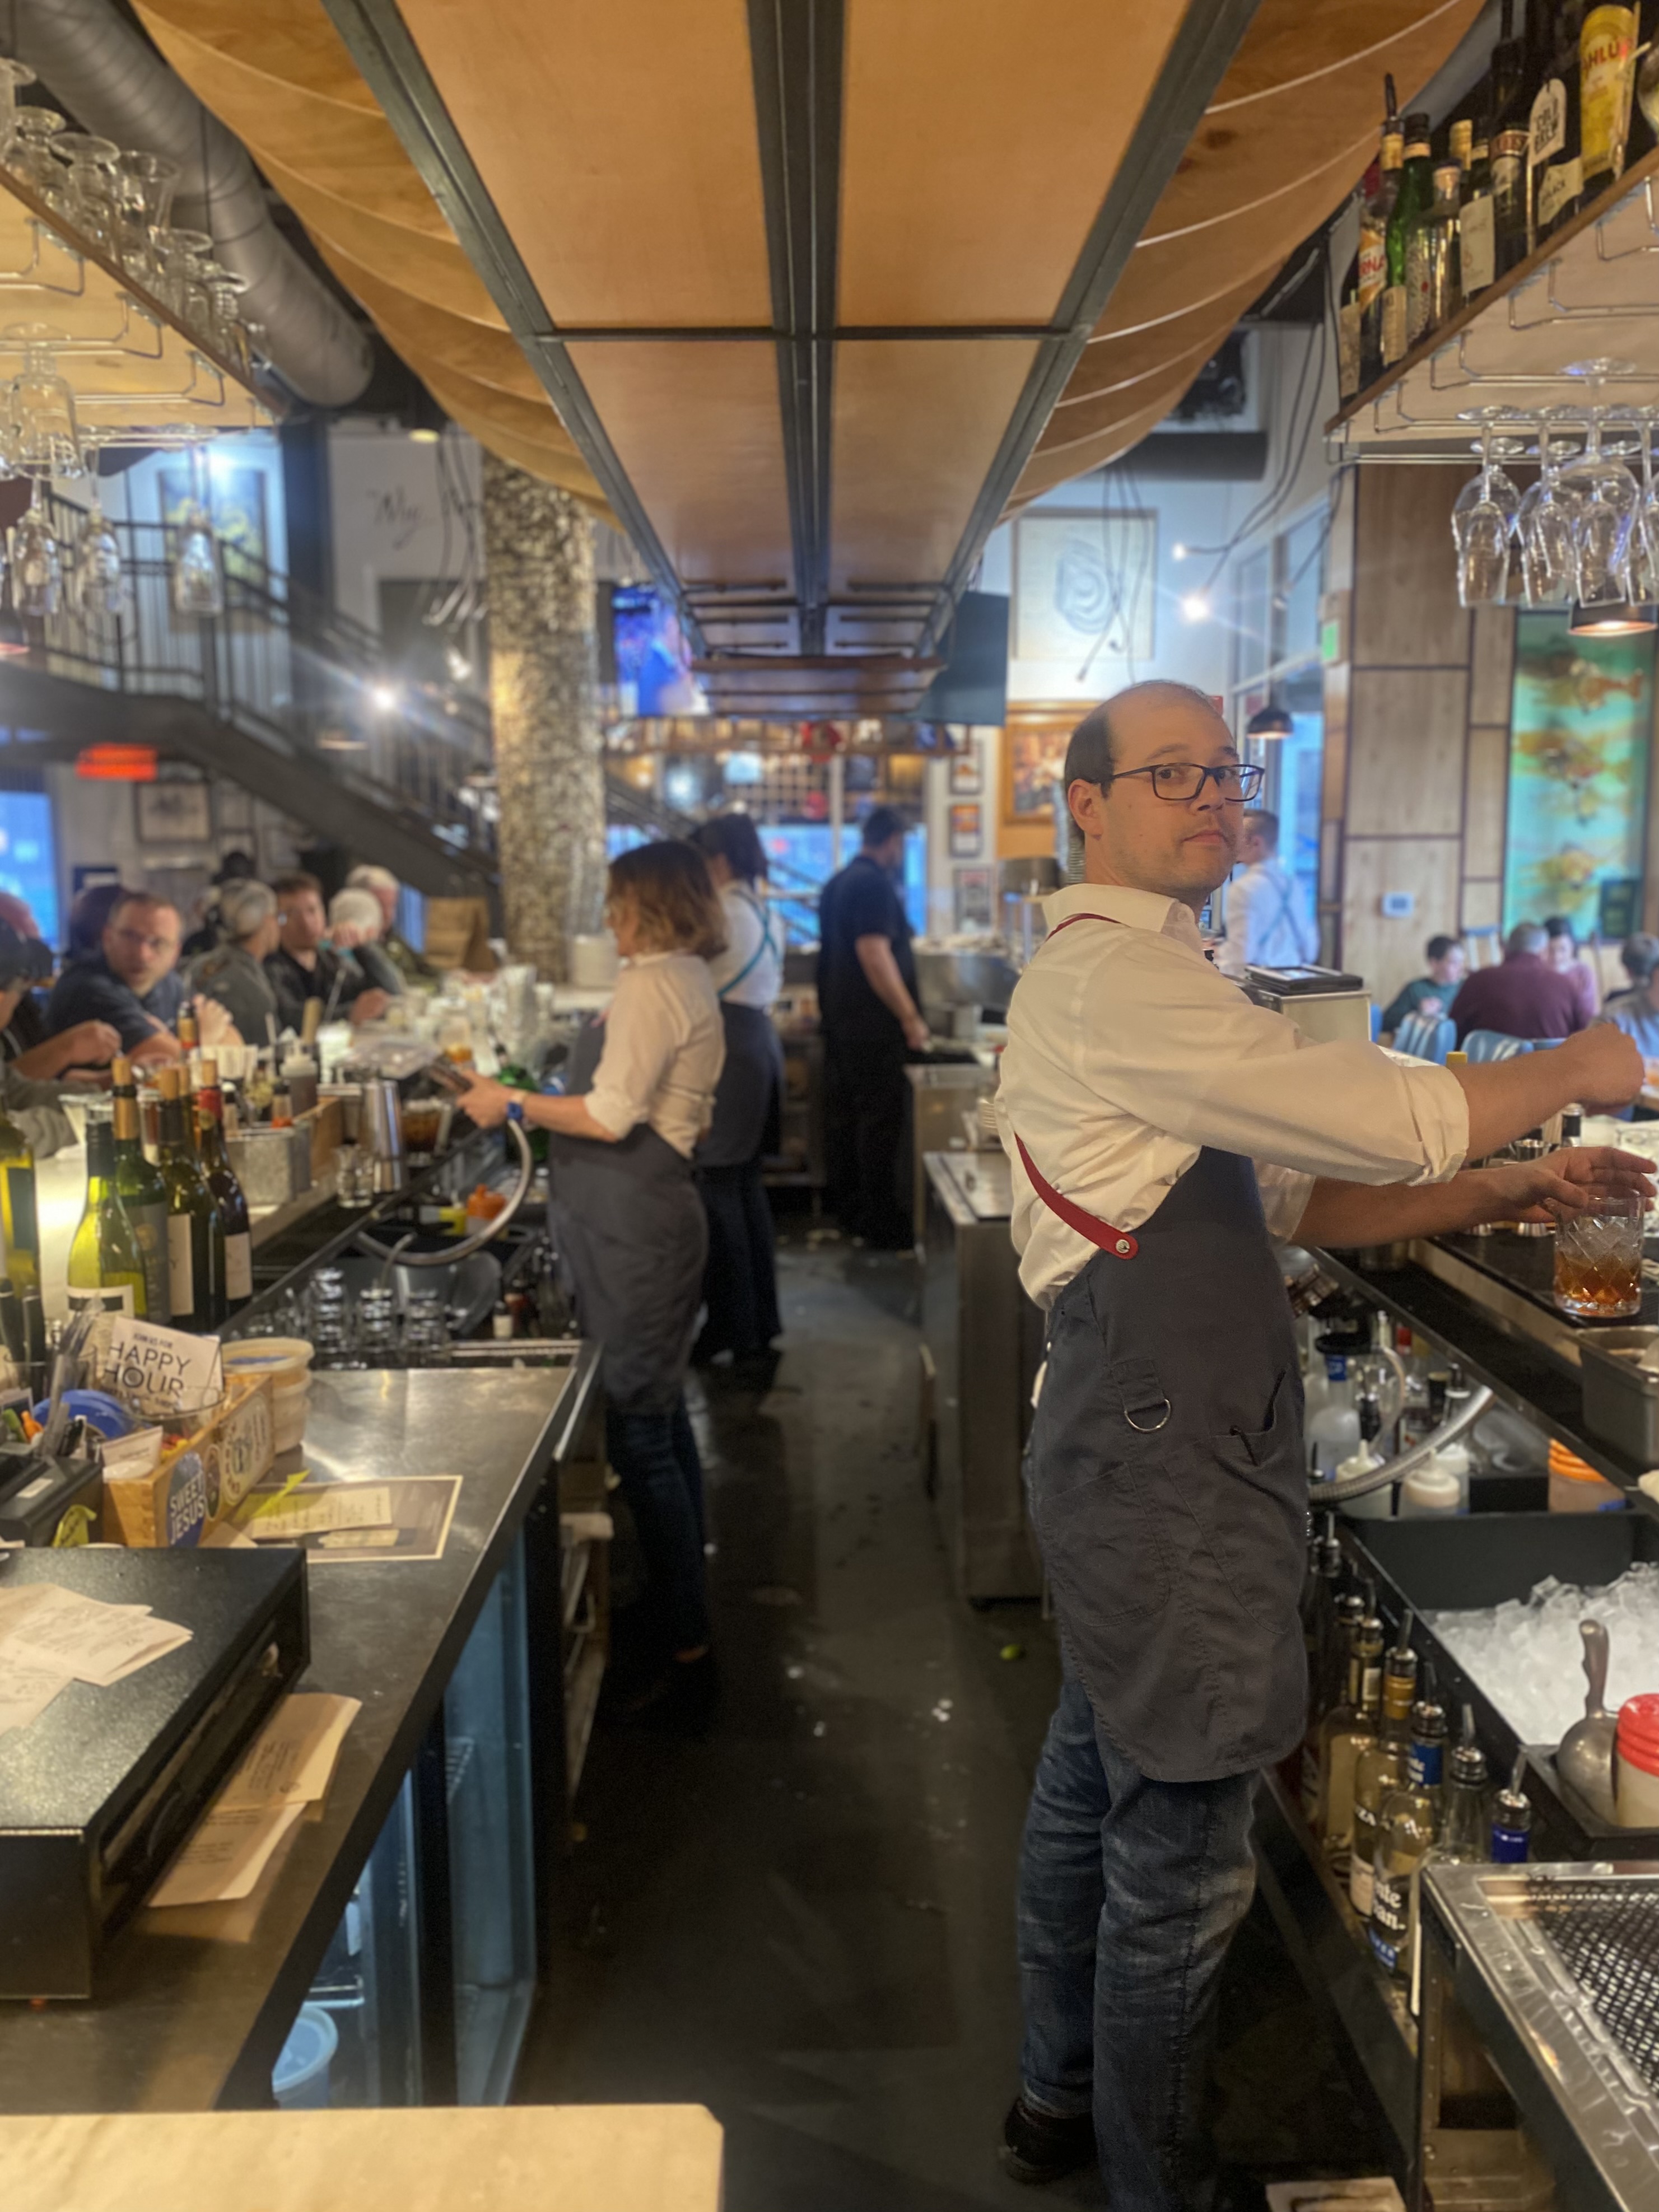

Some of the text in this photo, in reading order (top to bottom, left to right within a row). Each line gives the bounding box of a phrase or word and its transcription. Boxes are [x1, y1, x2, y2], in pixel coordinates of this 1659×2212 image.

[108, 1341, 192, 1376] HAPPY
[104, 1362, 184, 1399] HOUR
[169, 1468, 206, 1518] SWEET
[169, 1495, 208, 1545] JESUS
